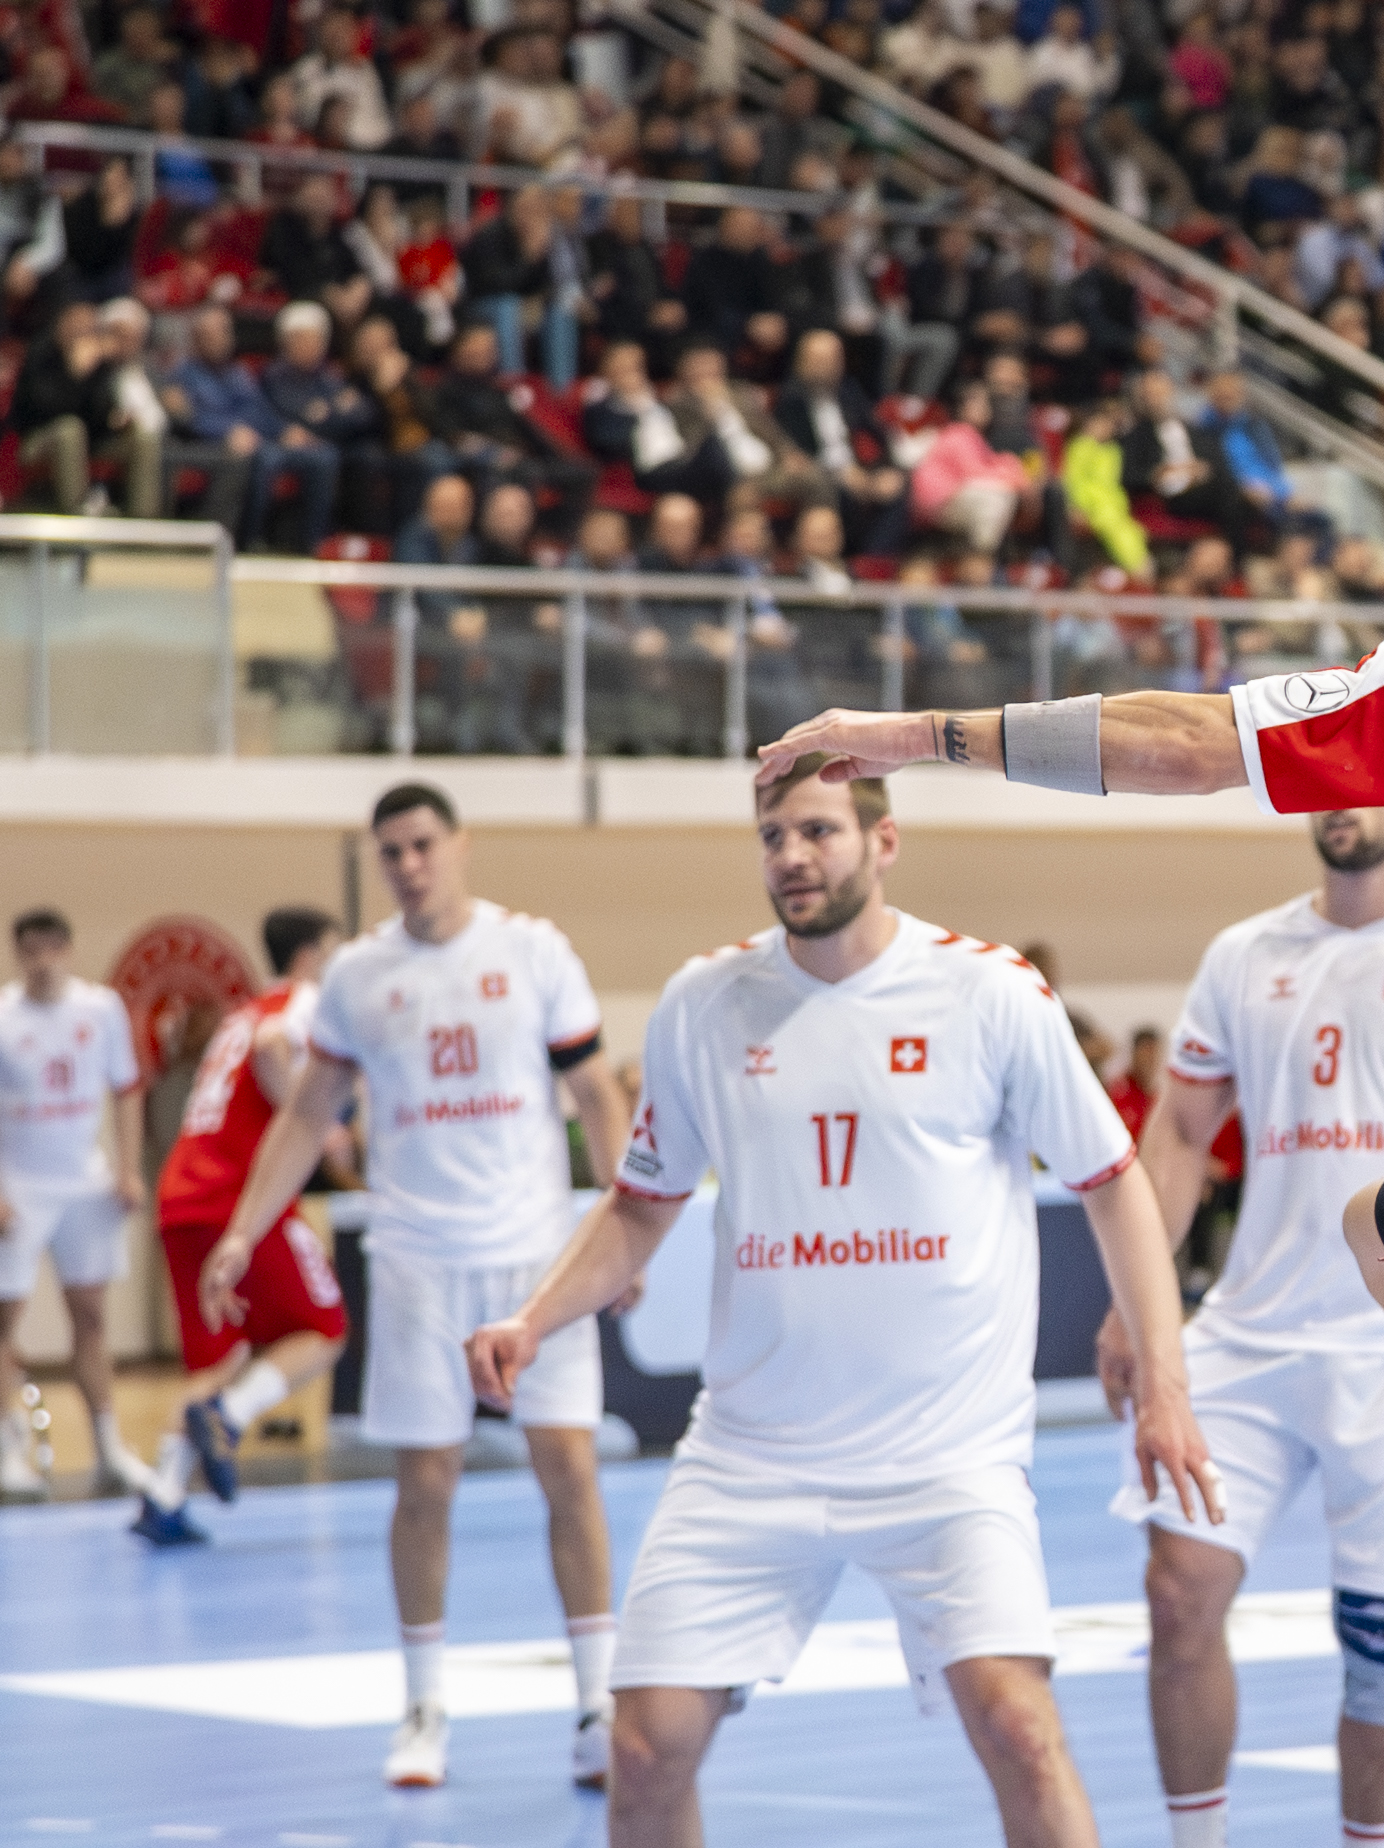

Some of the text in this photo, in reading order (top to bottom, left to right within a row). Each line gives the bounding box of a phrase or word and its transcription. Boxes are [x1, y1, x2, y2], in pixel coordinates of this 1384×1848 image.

[427, 1022, 479, 1078] 20
[1311, 1024, 1343, 1088] 3
[810, 1112, 860, 1188] 17
[736, 1228, 951, 1272] die Mobiliar
